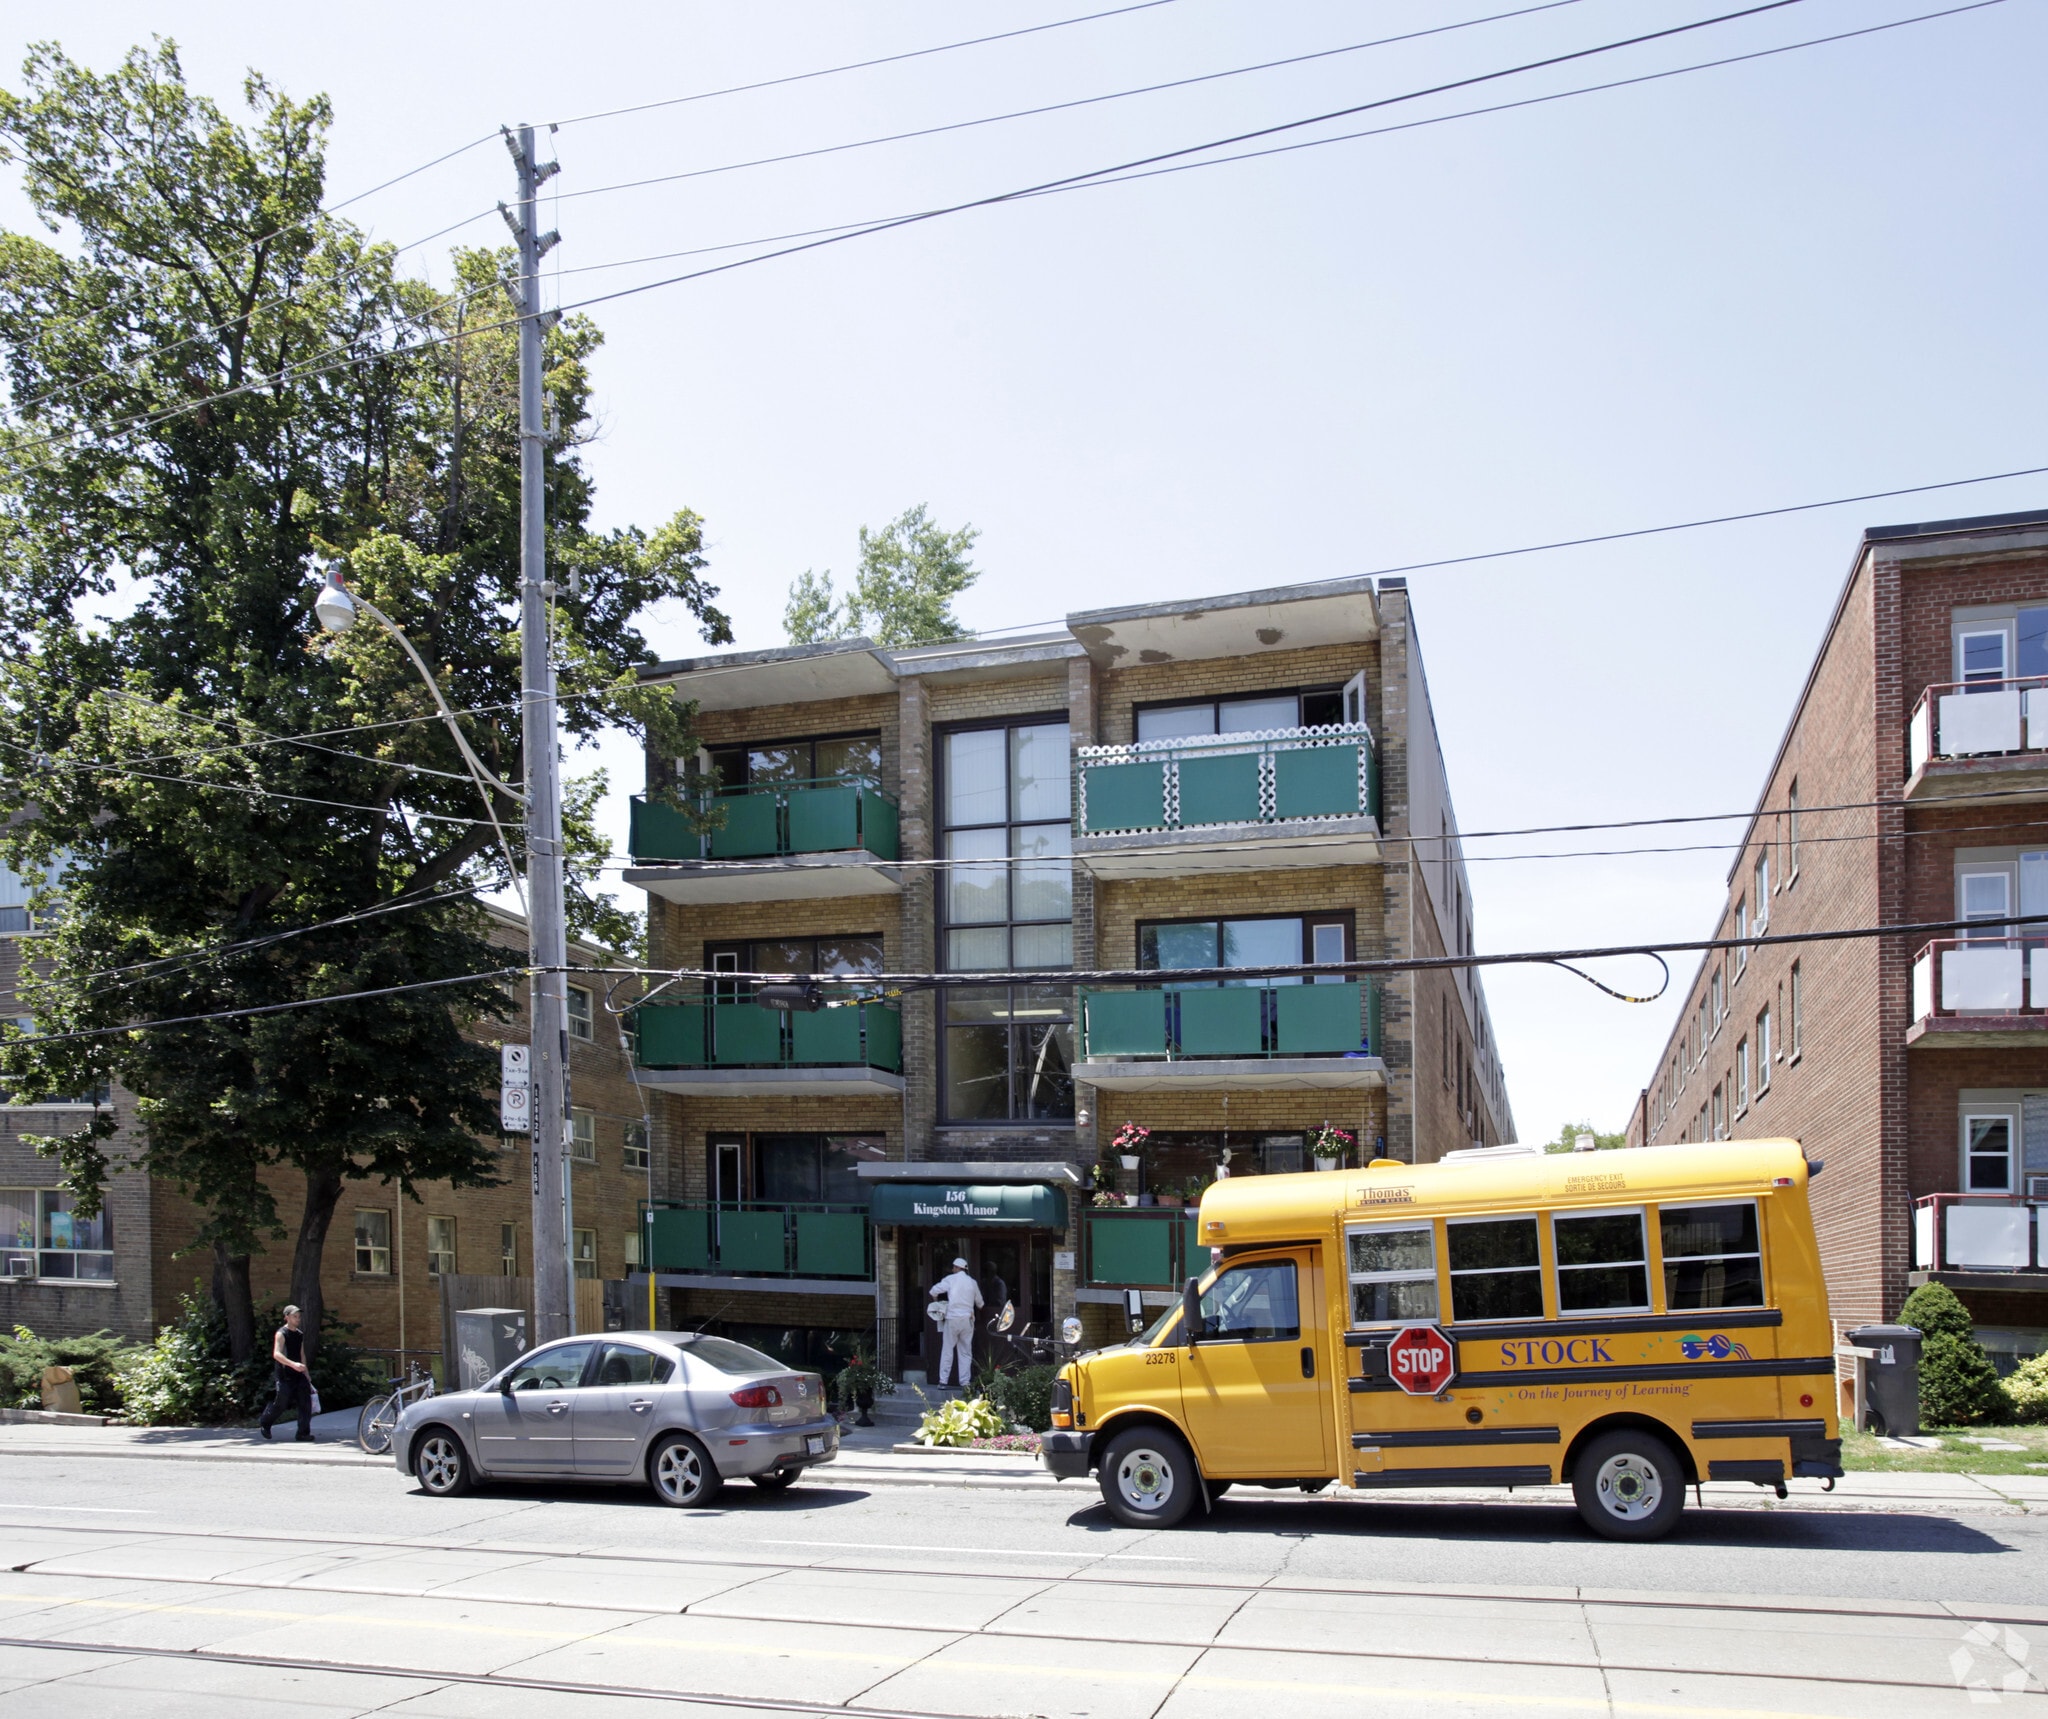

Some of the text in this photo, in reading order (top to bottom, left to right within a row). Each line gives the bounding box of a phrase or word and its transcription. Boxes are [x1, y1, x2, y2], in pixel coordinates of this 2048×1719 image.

[1567, 1173, 1623, 1184] EMERGENCY EXIT
[1564, 1180, 1626, 1193] SORTIE DE SECOURS
[945, 1190, 966, 1202] 156
[1357, 1187, 1411, 1200] Thomas
[913, 1202, 999, 1218] Kingston Manor
[1145, 1352, 1176, 1365] 23278
[1501, 1338, 1615, 1366] STOCK
[1396, 1347, 1444, 1374] STOP
[1517, 1383, 1691, 1401] On the Journey of Learning
